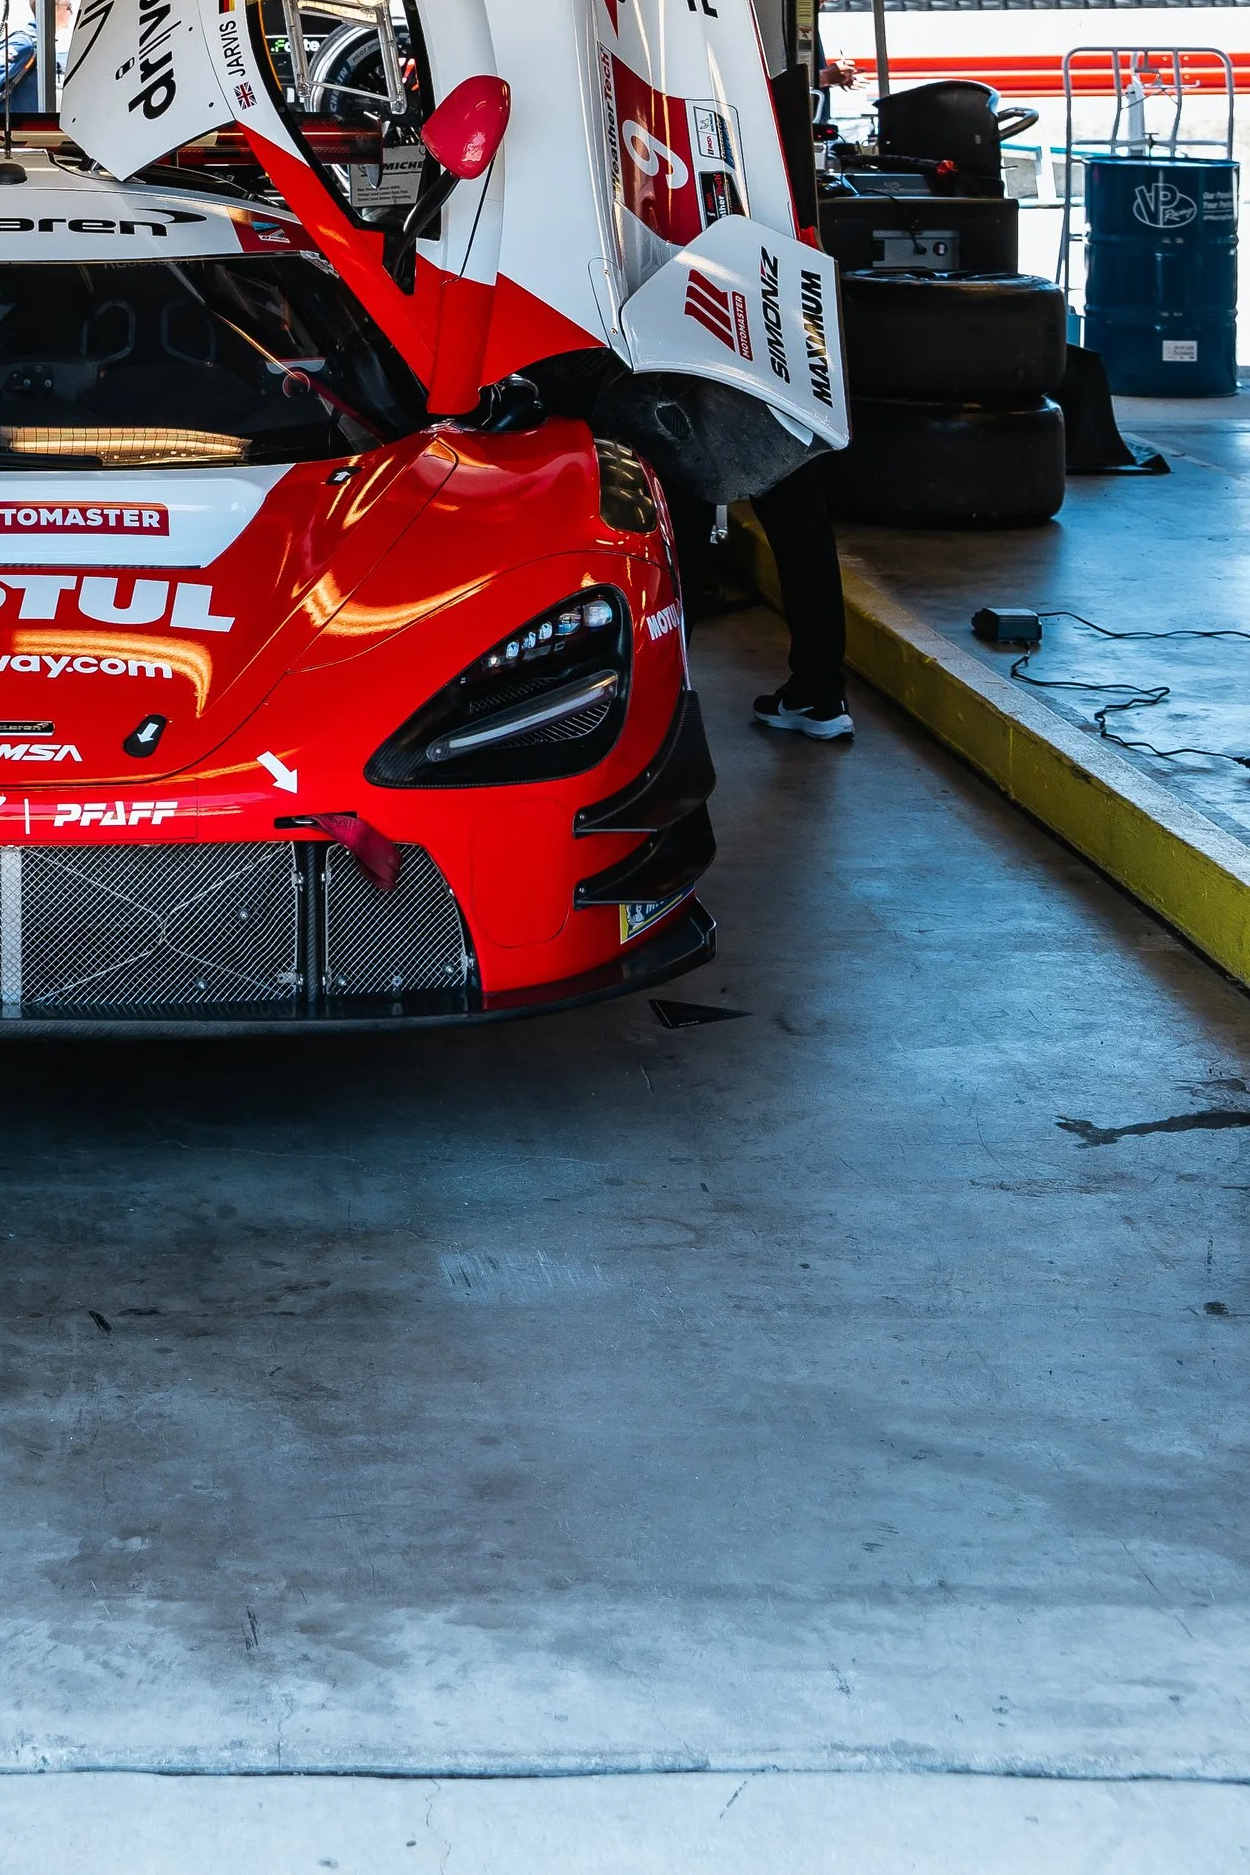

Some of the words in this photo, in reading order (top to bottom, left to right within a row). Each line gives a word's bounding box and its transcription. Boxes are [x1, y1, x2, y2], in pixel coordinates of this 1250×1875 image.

[220, 20, 246, 76] JARVIS
[622, 120, 689, 189] 9
[1134, 183, 1179, 226] VP
[735, 294, 750, 358] MOTOMASTER
[800, 269, 833, 408] MAXIMUM
[54, 801, 178, 827] PFAFF
